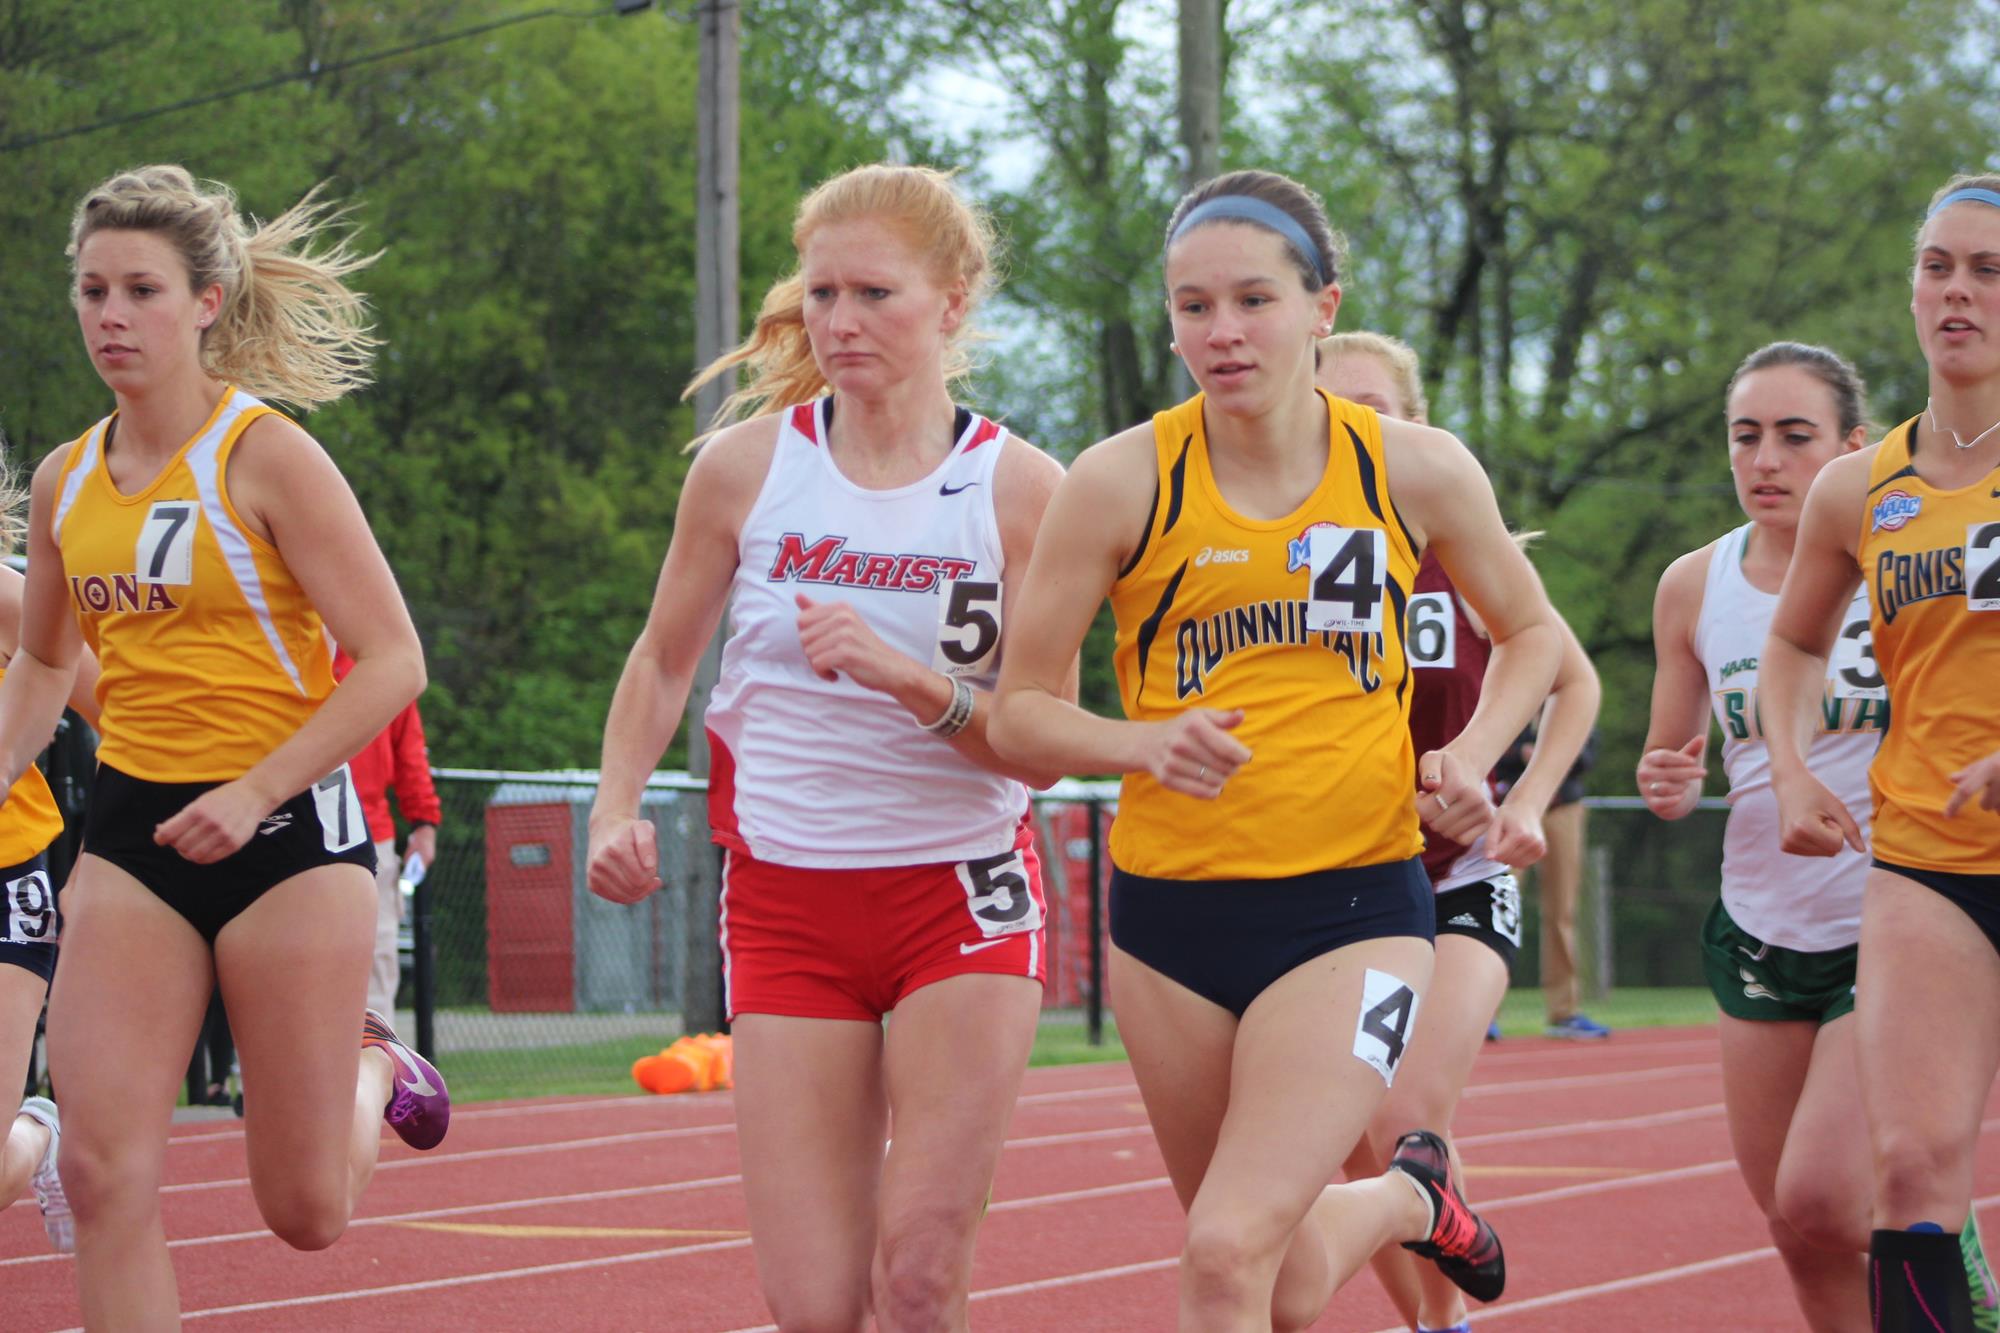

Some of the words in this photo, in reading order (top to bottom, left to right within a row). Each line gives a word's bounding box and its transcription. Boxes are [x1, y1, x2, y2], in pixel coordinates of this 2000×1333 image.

[149, 507, 190, 578] 7
[767, 532, 977, 594] MARIST
[1212, 549, 1249, 563] asics
[1312, 529, 1382, 619] 4
[69, 573, 182, 613] IONA
[1877, 545, 1967, 625] CANIS
[940, 581, 998, 665] 5
[1408, 597, 1447, 662] 6
[1839, 620, 1887, 688] 3
[1720, 657, 1758, 682] MAAC
[318, 767, 350, 847] 7
[16, 875, 51, 938] 9
[966, 851, 1031, 923] 5
[1361, 984, 1415, 1070] 4
